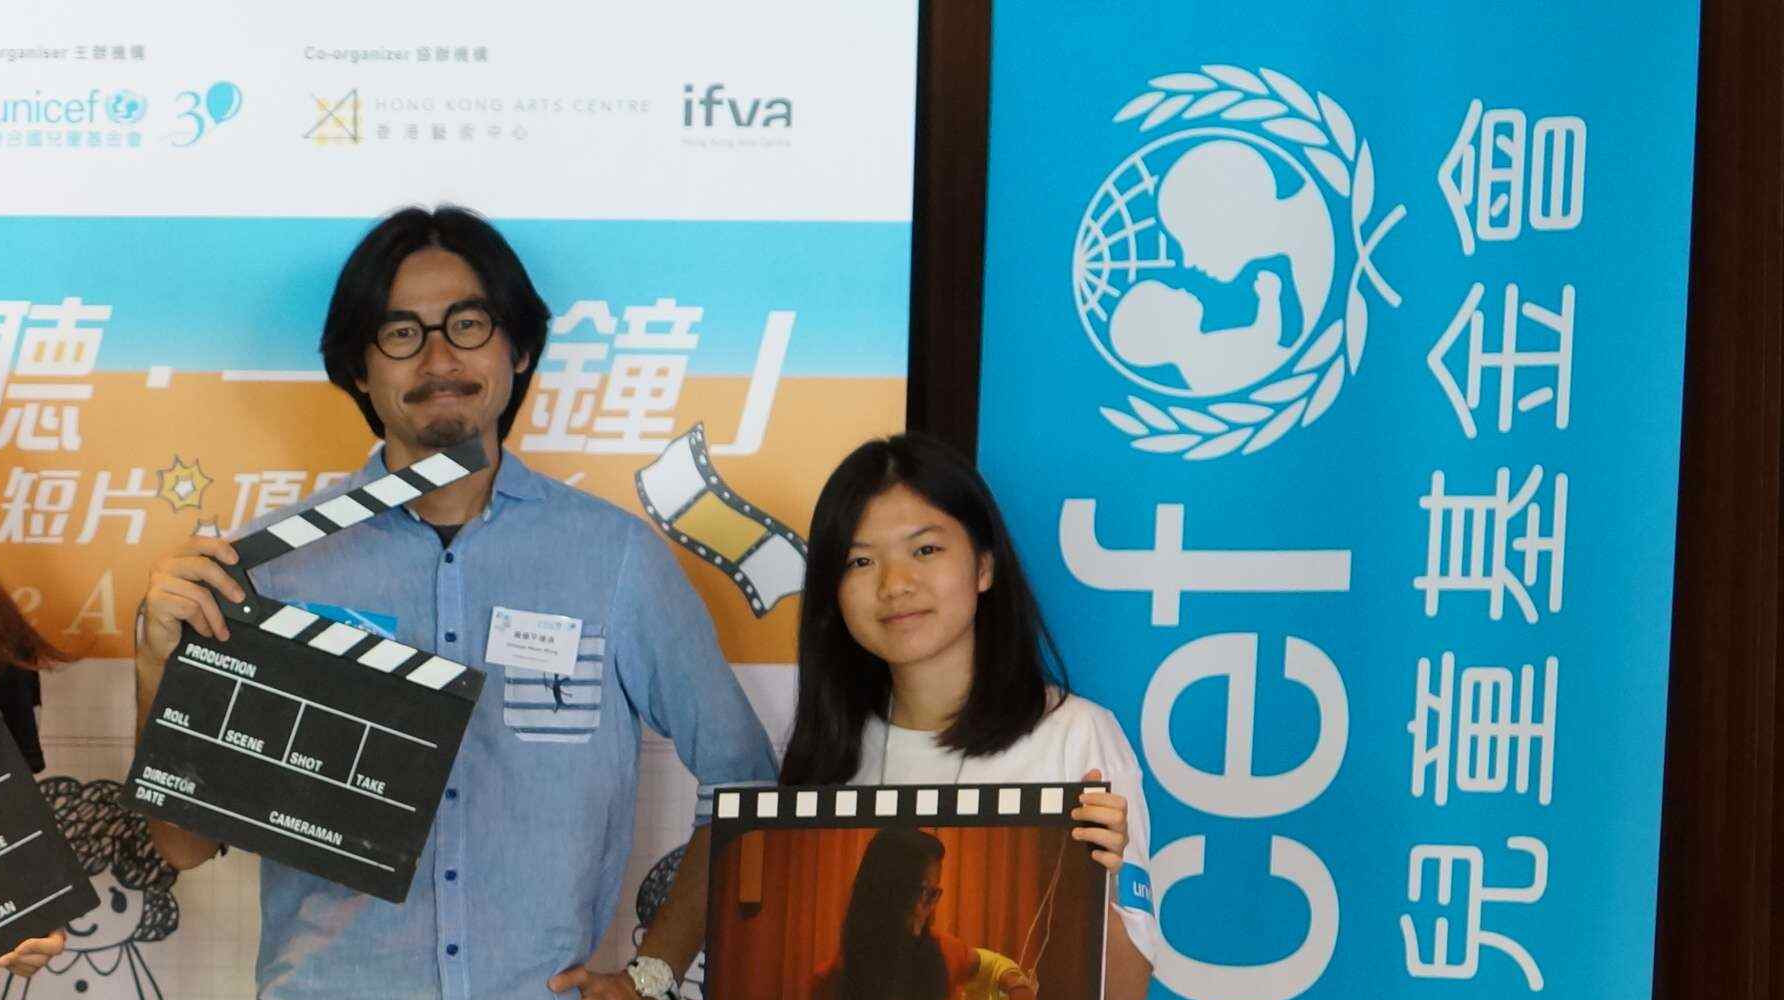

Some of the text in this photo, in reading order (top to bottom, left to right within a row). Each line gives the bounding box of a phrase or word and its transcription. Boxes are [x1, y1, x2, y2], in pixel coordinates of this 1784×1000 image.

[375, 97, 652, 114] HONG KONG ARTS CENTRE
[682, 82, 793, 128] ifva
[185, 643, 258, 679] PRODUCTION
[163, 707, 387, 796] ROLL SCENE SHOT TAKE
[135, 786, 166, 808] DATE
[142, 765, 344, 847] DIRECTOR CAMERAMAN
